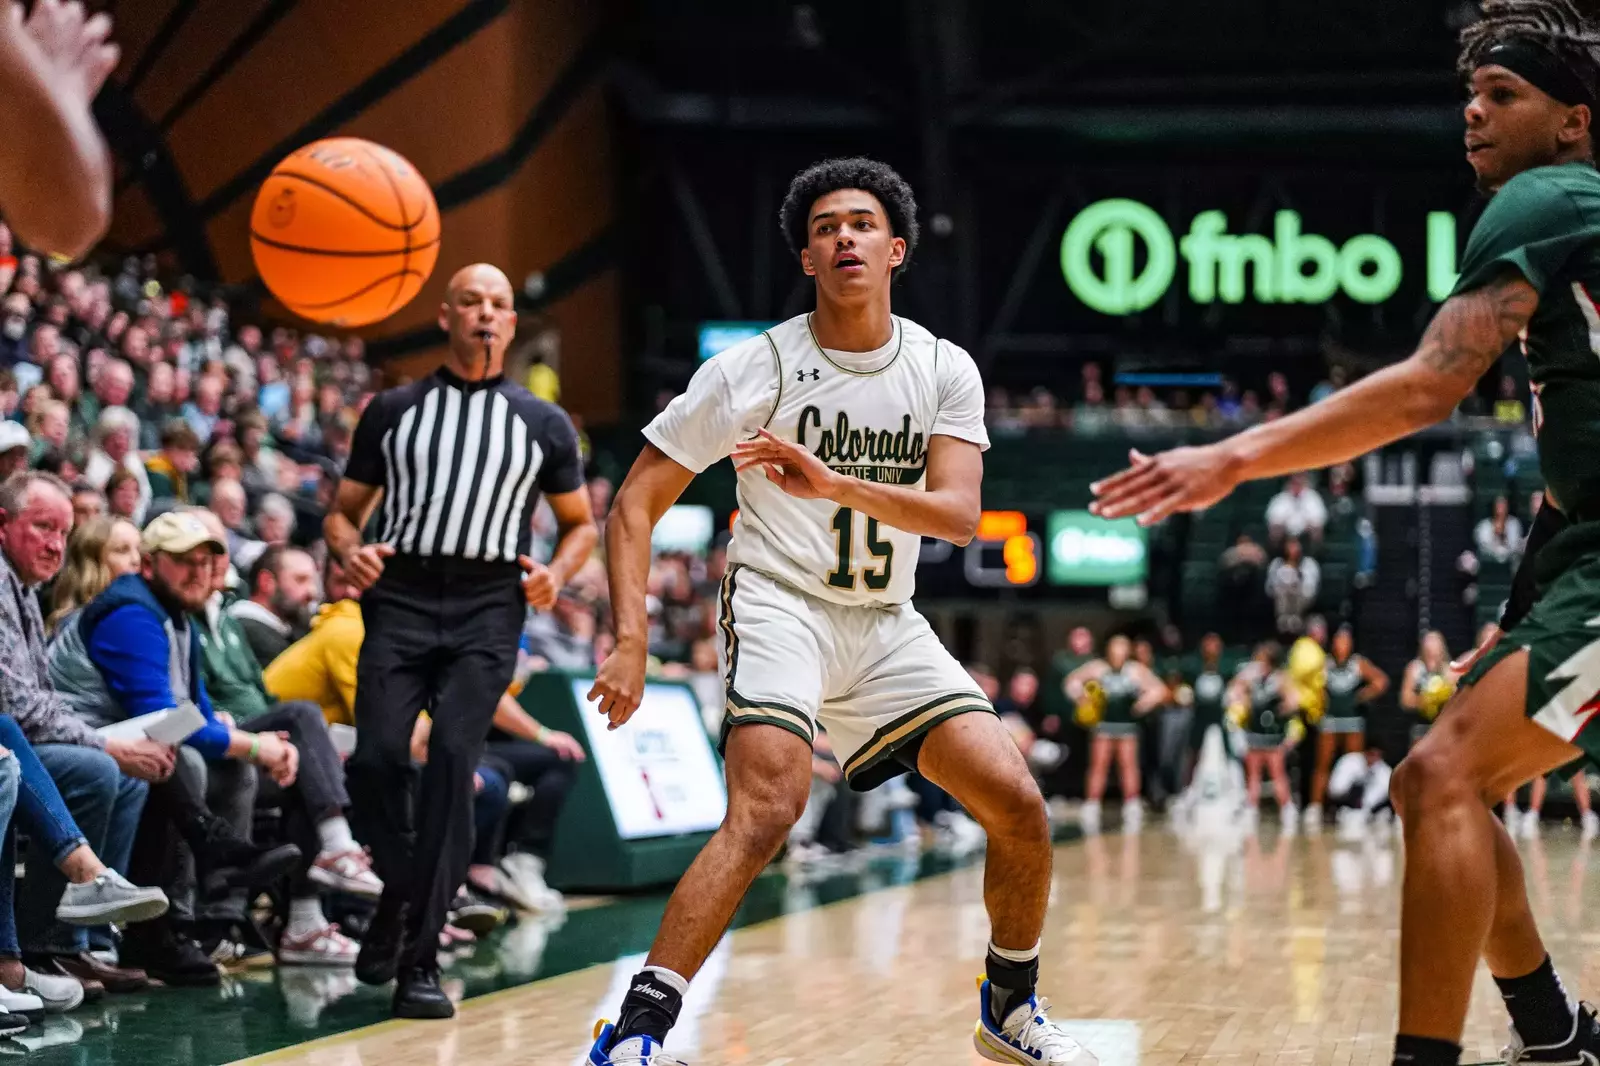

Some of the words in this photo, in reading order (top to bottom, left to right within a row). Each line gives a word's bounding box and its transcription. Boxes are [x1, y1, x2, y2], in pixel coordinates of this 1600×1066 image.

[1180, 208, 1403, 304] fnbo
[797, 405, 924, 465] Colorado
[877, 467, 903, 484] UNIV
[827, 504, 895, 591] 15
